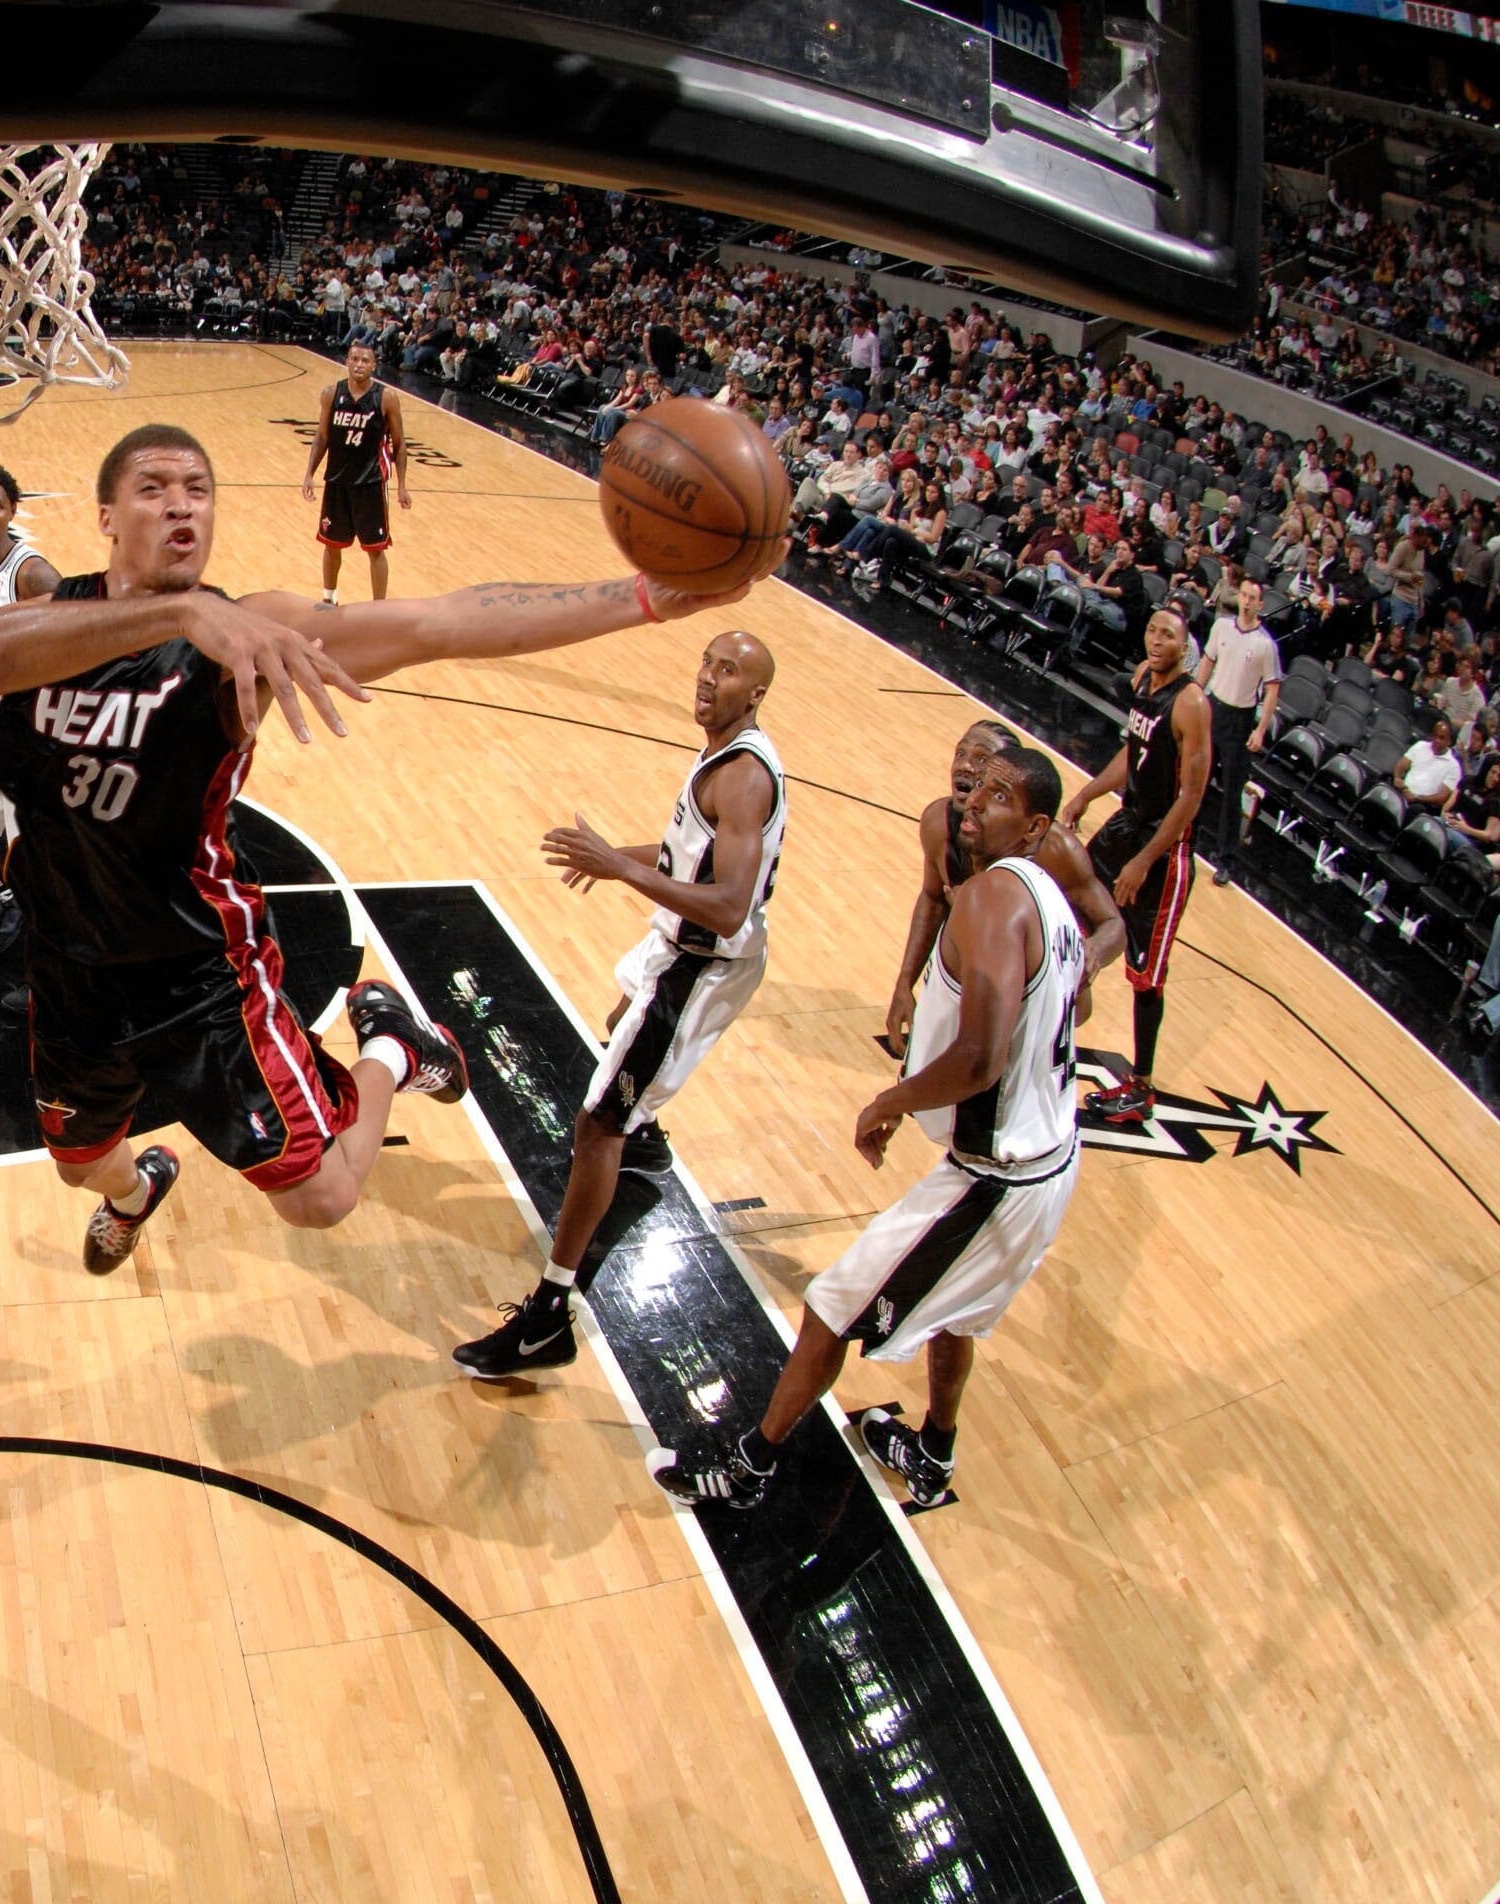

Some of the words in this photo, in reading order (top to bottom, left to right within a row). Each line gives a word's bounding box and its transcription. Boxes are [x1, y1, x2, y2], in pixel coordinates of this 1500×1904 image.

[996, 4, 1052, 61] NBA
[333, 410, 375, 429] HEAT
[344, 430, 364, 447] 14
[35, 674, 182, 749] HEAT
[1128, 708, 1163, 742] HEAT
[1135, 746, 1149, 772] 7
[61, 754, 139, 823] 30
